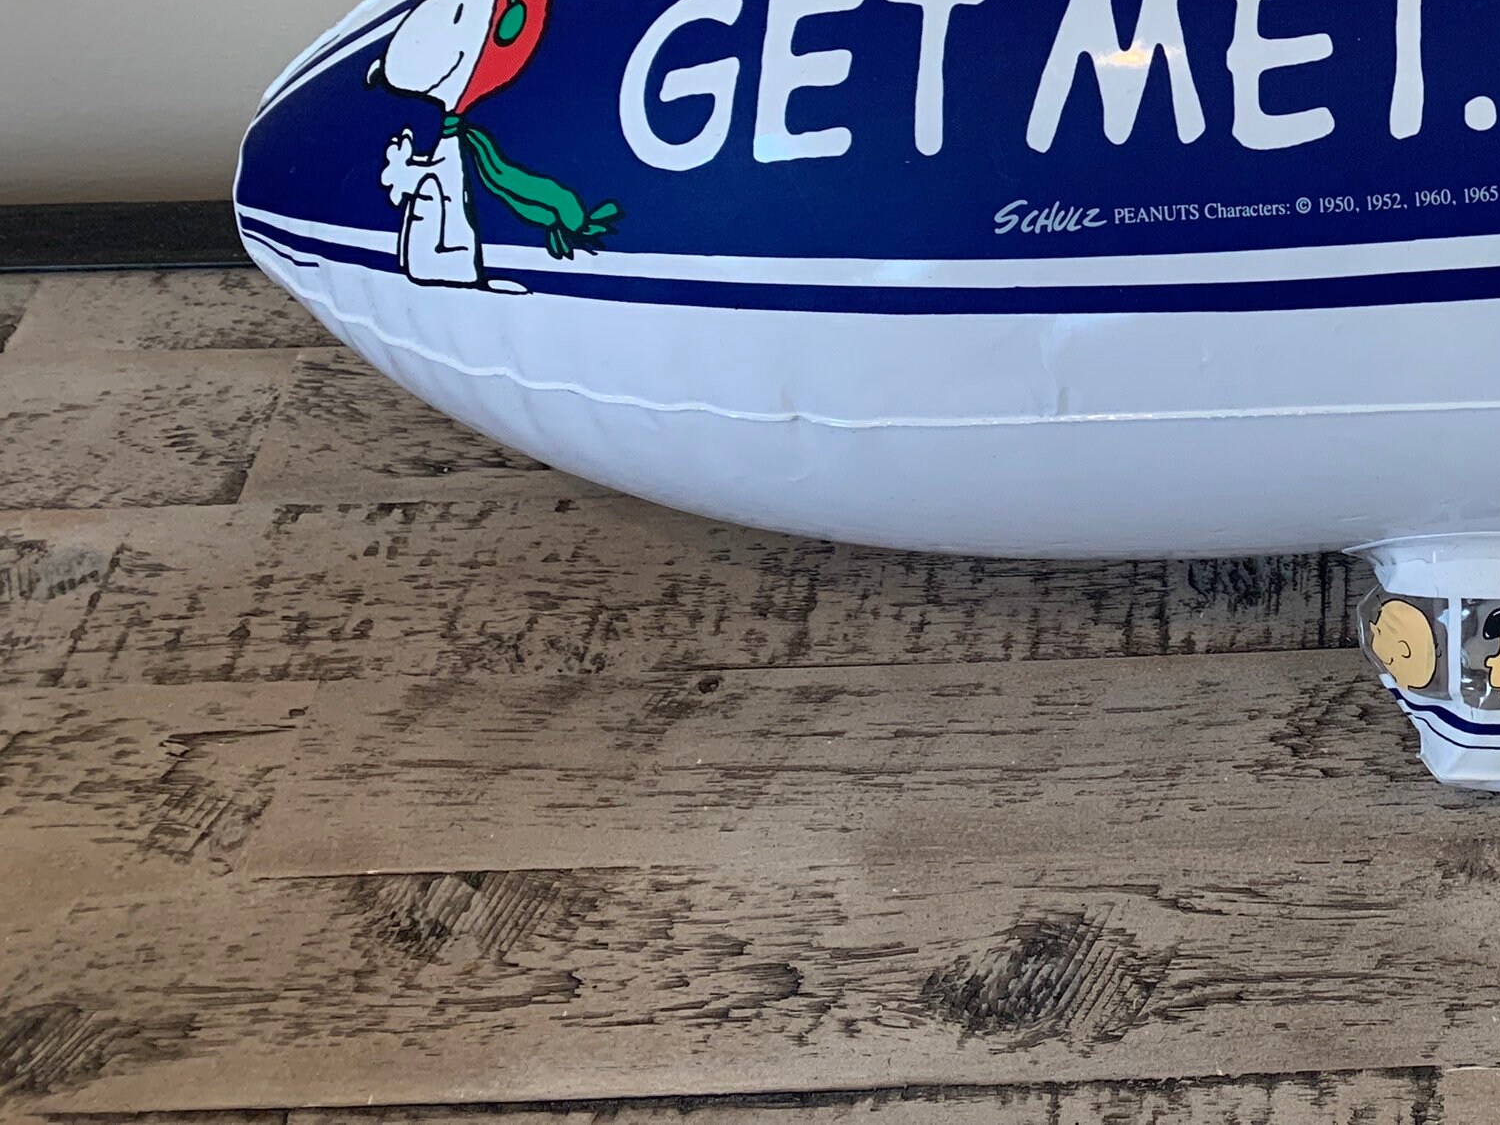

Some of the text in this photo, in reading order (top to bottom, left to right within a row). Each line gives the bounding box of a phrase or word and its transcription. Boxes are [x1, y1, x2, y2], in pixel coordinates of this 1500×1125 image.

[1113, 204, 1200, 224] PEANUTS
[1204, 201, 1291, 219] Characters:
[1318, 195, 1360, 215] 1950,
[1366, 192, 1408, 211] 1952,
[1414, 188, 1457, 207] 1960,
[1464, 185, 1499, 204] 1965
